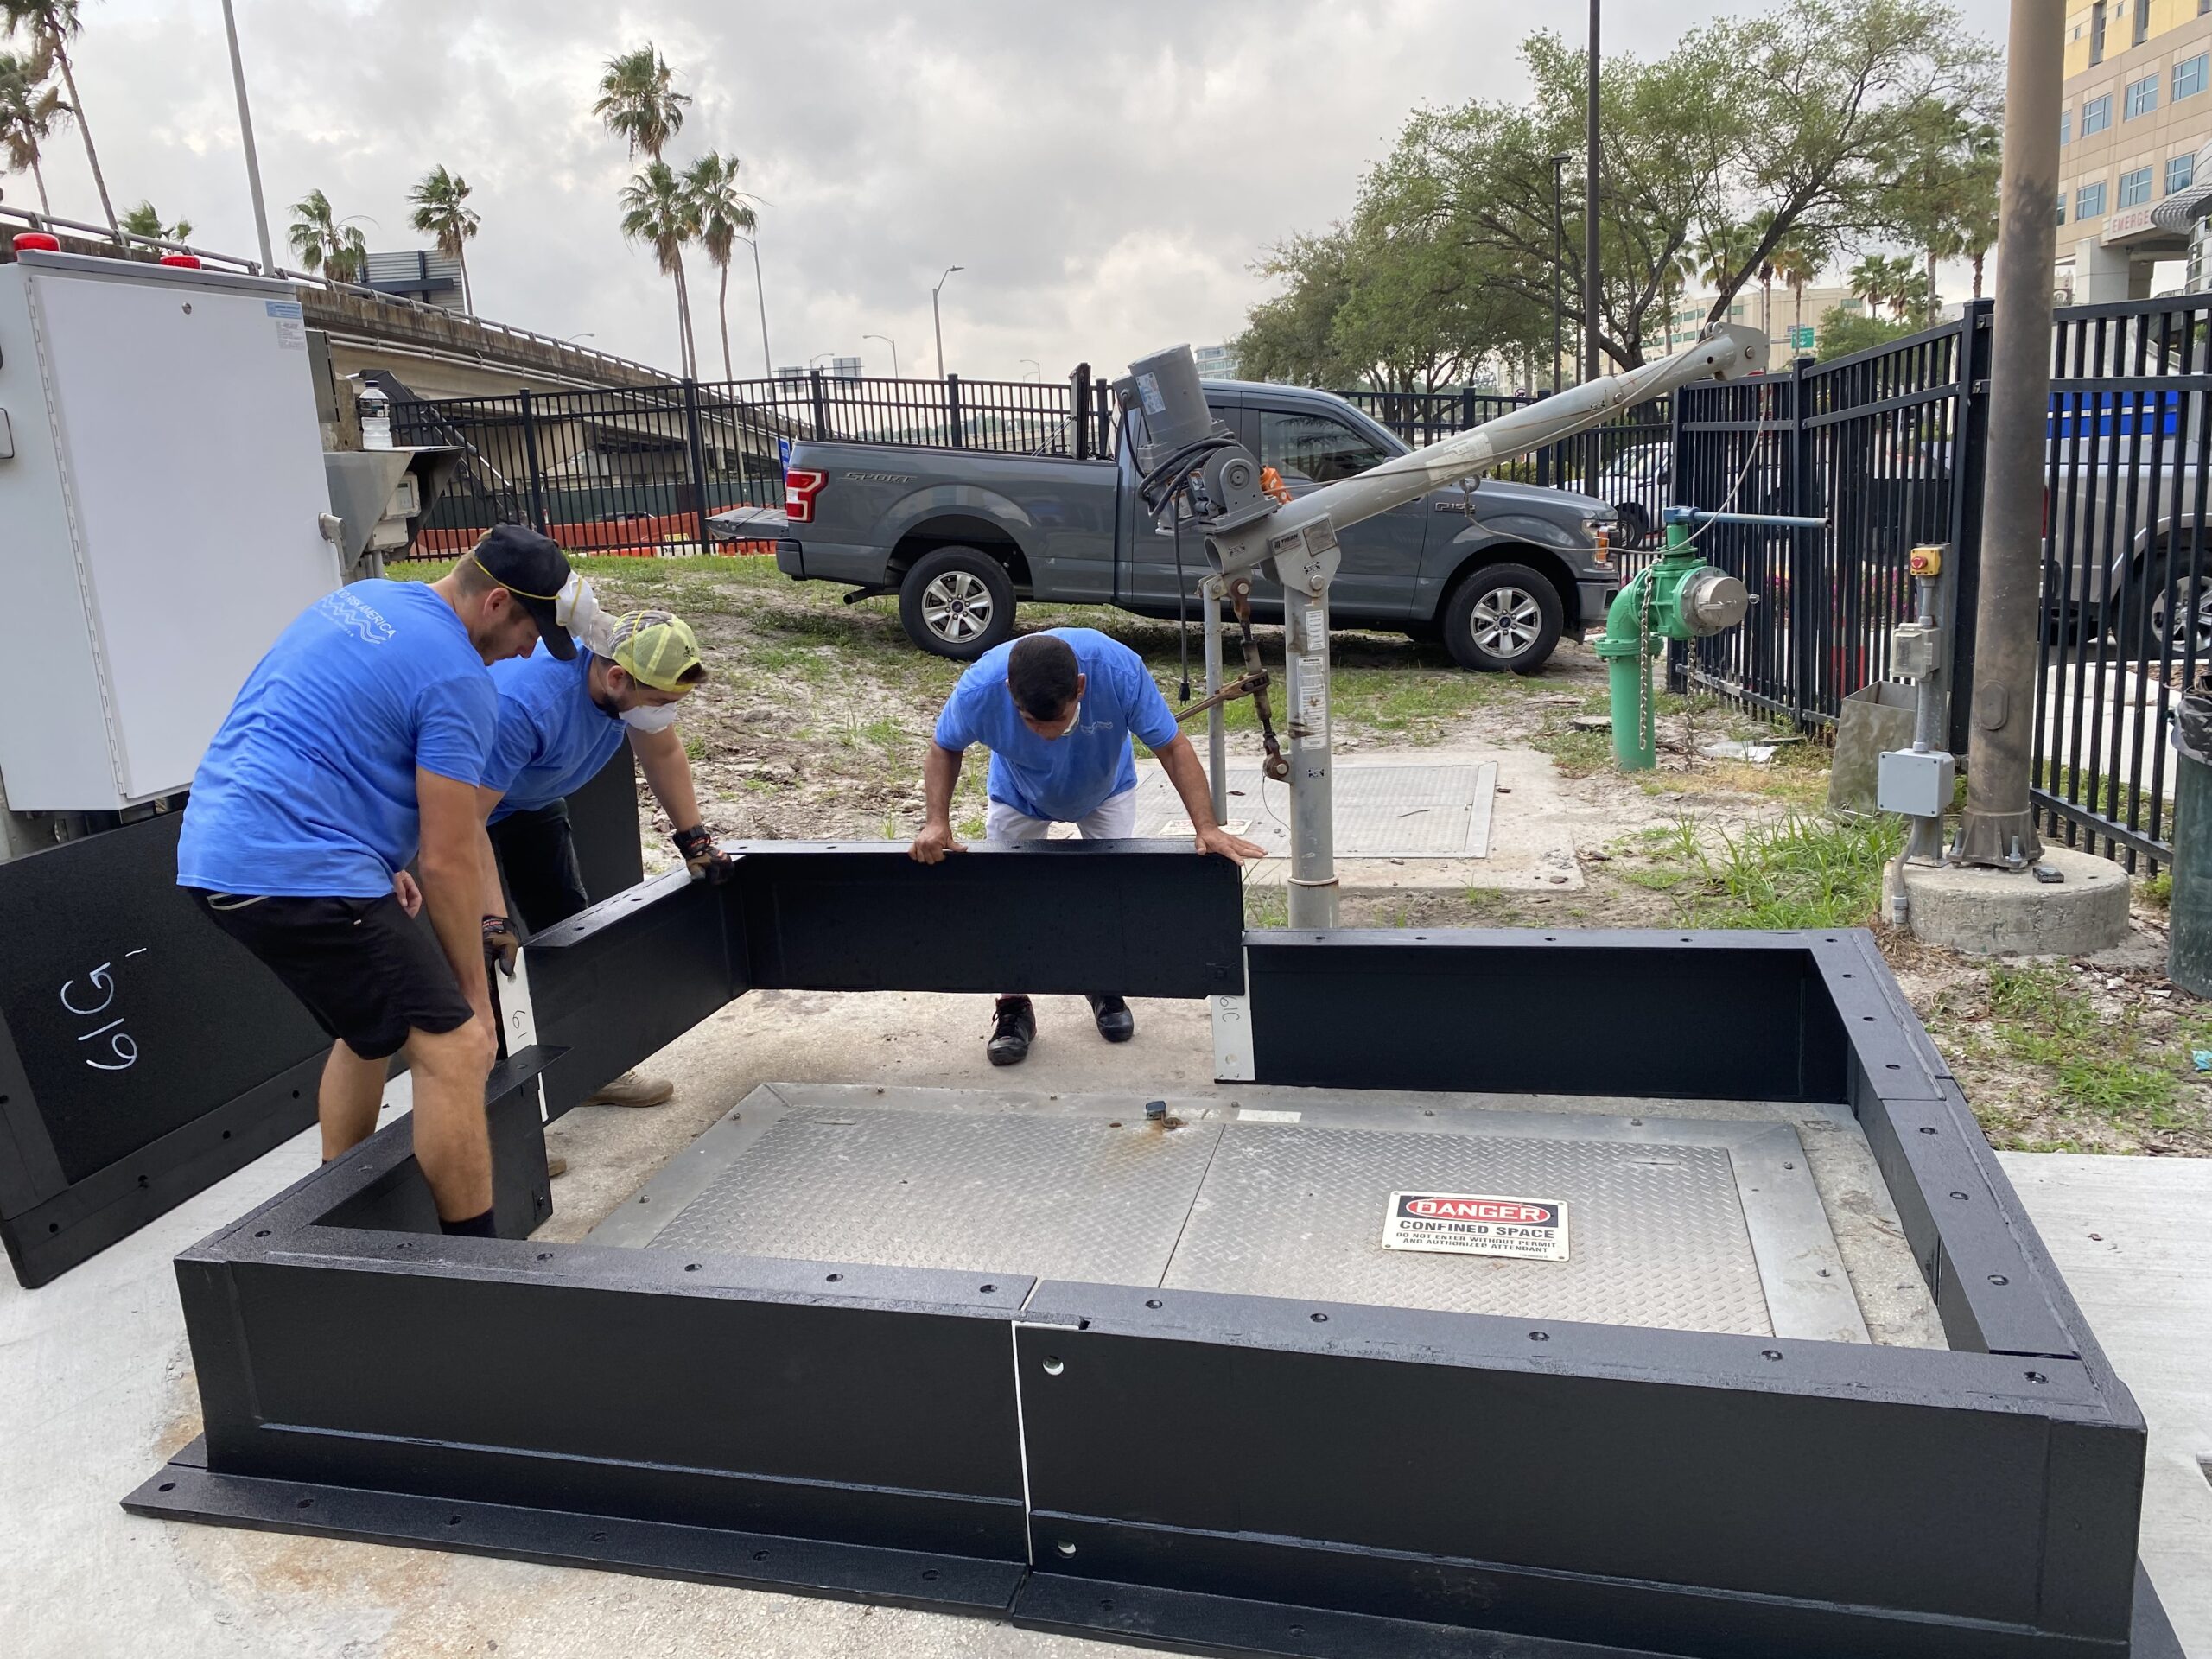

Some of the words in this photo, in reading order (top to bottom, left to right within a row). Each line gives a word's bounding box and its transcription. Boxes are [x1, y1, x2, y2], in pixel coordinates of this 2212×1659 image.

[2112, 209, 2150, 233] EMERGE
[836, 472, 918, 483] SPORT
[357, 605, 397, 638] AMERICA
[1416, 1200, 1541, 1221] DANGER
[1399, 1220, 1489, 1234] CONFINED
[1496, 1226, 1555, 1239] SPACE
[1426, 1238, 1488, 1248] AUTHORIZED
[1491, 1243, 1548, 1253] ATTENDANT
[1469, 1236, 1515, 1245] WITHOUT
[1518, 1239, 1557, 1248] PERMIT
